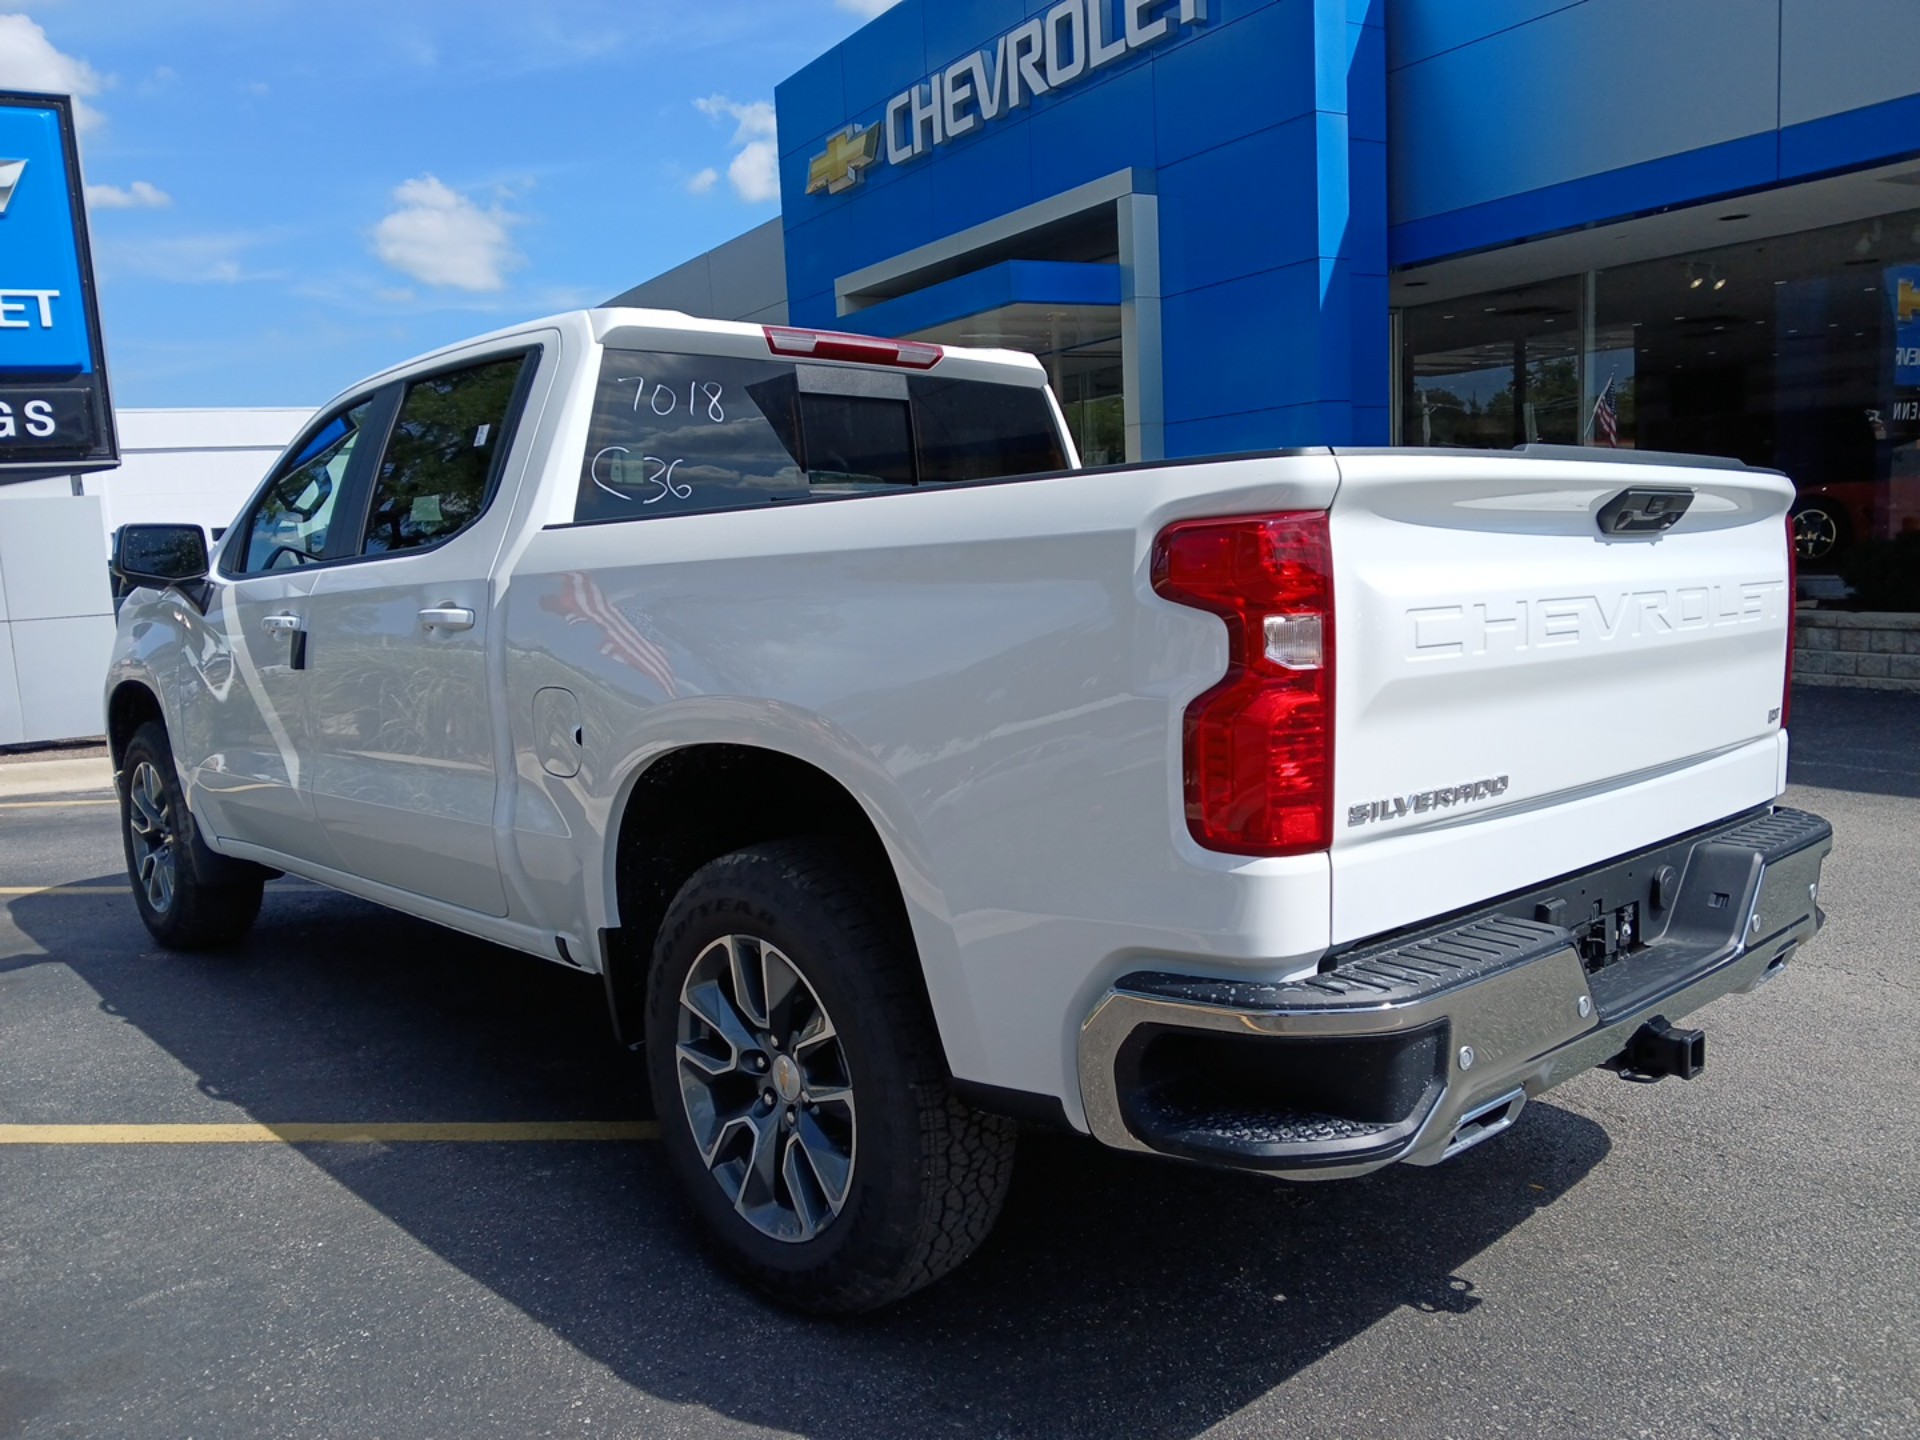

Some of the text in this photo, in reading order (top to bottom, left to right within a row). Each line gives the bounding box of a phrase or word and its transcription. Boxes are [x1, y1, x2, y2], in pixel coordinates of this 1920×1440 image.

[617, 376, 725, 423] 7018
[1404, 579, 1785, 662] CHEVROLET
[1347, 774, 1509, 828] SILVERADO
